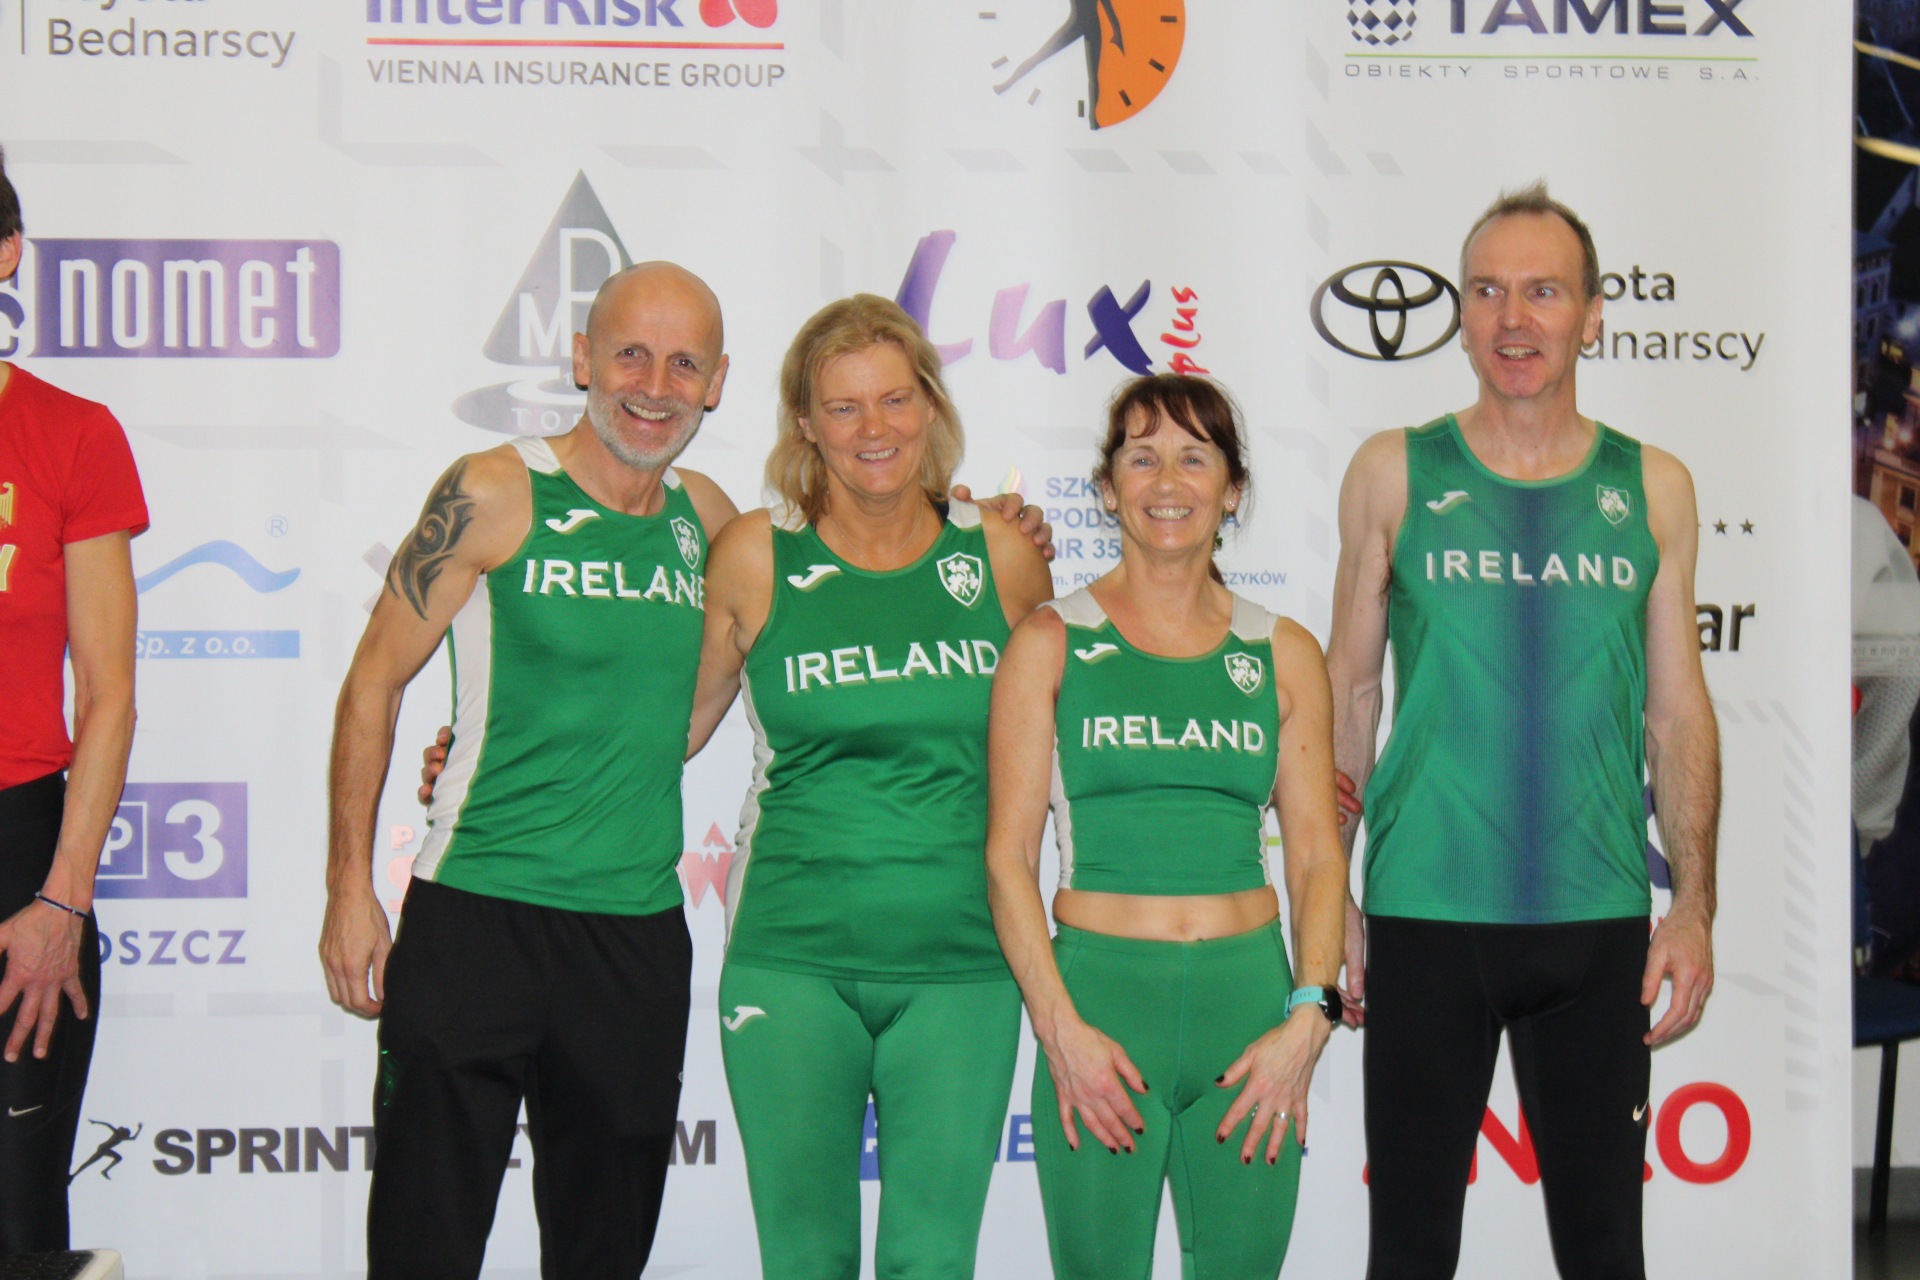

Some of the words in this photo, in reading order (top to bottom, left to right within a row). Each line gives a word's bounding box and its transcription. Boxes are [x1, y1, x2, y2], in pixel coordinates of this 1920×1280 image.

[1450, 0, 1755, 37] TAMEX
[48, 17, 296, 68] Bednarscy
[367, 59, 483, 84] VIENNA
[495, 60, 670, 87] INSURANCE
[681, 63, 785, 87] GROUP
[1345, 64, 1473, 78] OBIEKTY
[1504, 65, 1671, 79] SPORTOWE
[1699, 67, 1760, 81] S.A.
[60, 247, 315, 348] nomet
[1599, 264, 1675, 301] ota
[896, 229, 1155, 376] Lux
[1579, 319, 1766, 371] dnarscy
[1046, 477, 1098, 498] SZK
[1093, 540, 1121, 559] 35
[1426, 550, 1634, 586] IRELAND
[180, 638, 196, 654] z
[204, 638, 257, 654] o.o.
[1696, 604, 1755, 652] ar
[785, 640, 999, 692] IRELAND
[1082, 715, 1263, 752] IRELAND
[163, 799, 224, 881] 3
